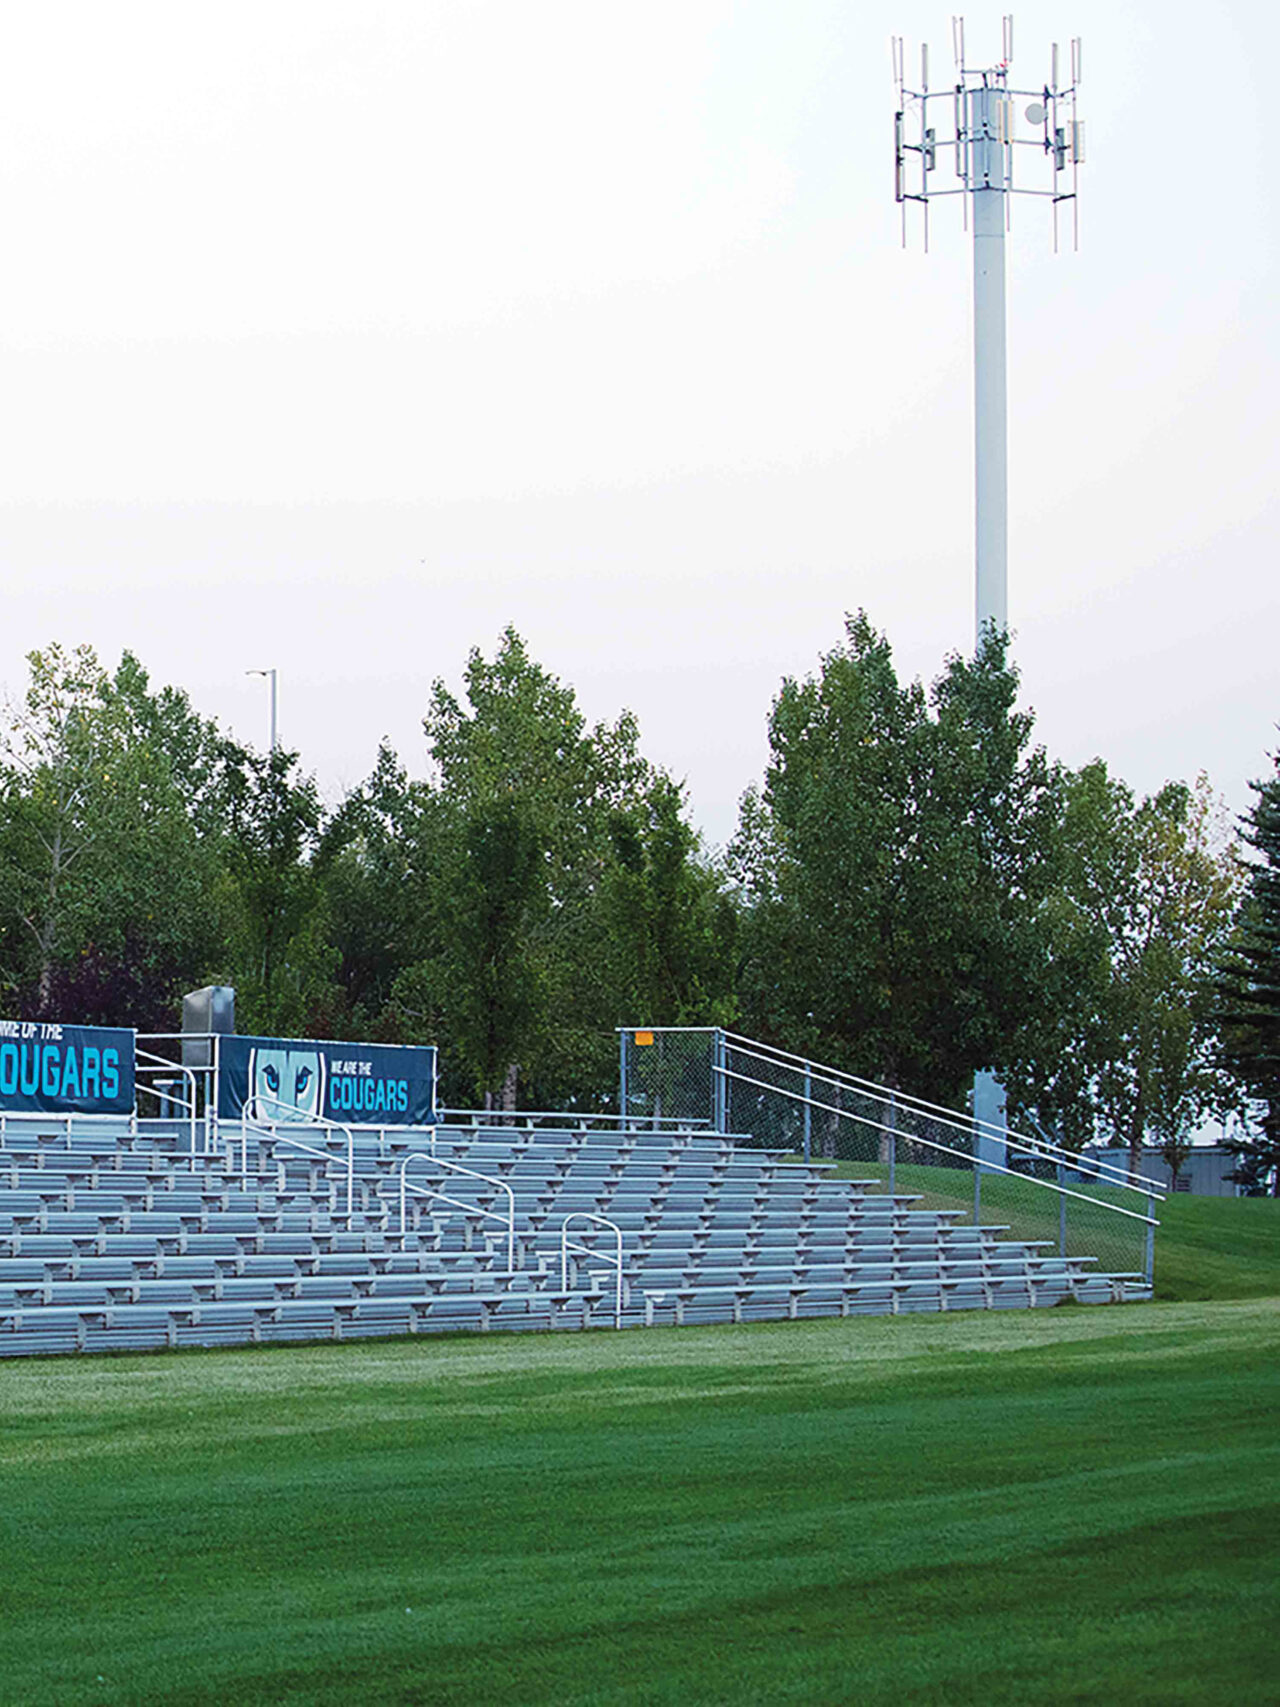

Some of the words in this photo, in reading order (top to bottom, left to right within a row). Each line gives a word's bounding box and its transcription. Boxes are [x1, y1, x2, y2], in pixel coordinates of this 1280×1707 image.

[21, 1022, 38, 1039] OF
[40, 1024, 64, 1041] THE
[329, 1076, 409, 1112] COUGARS
